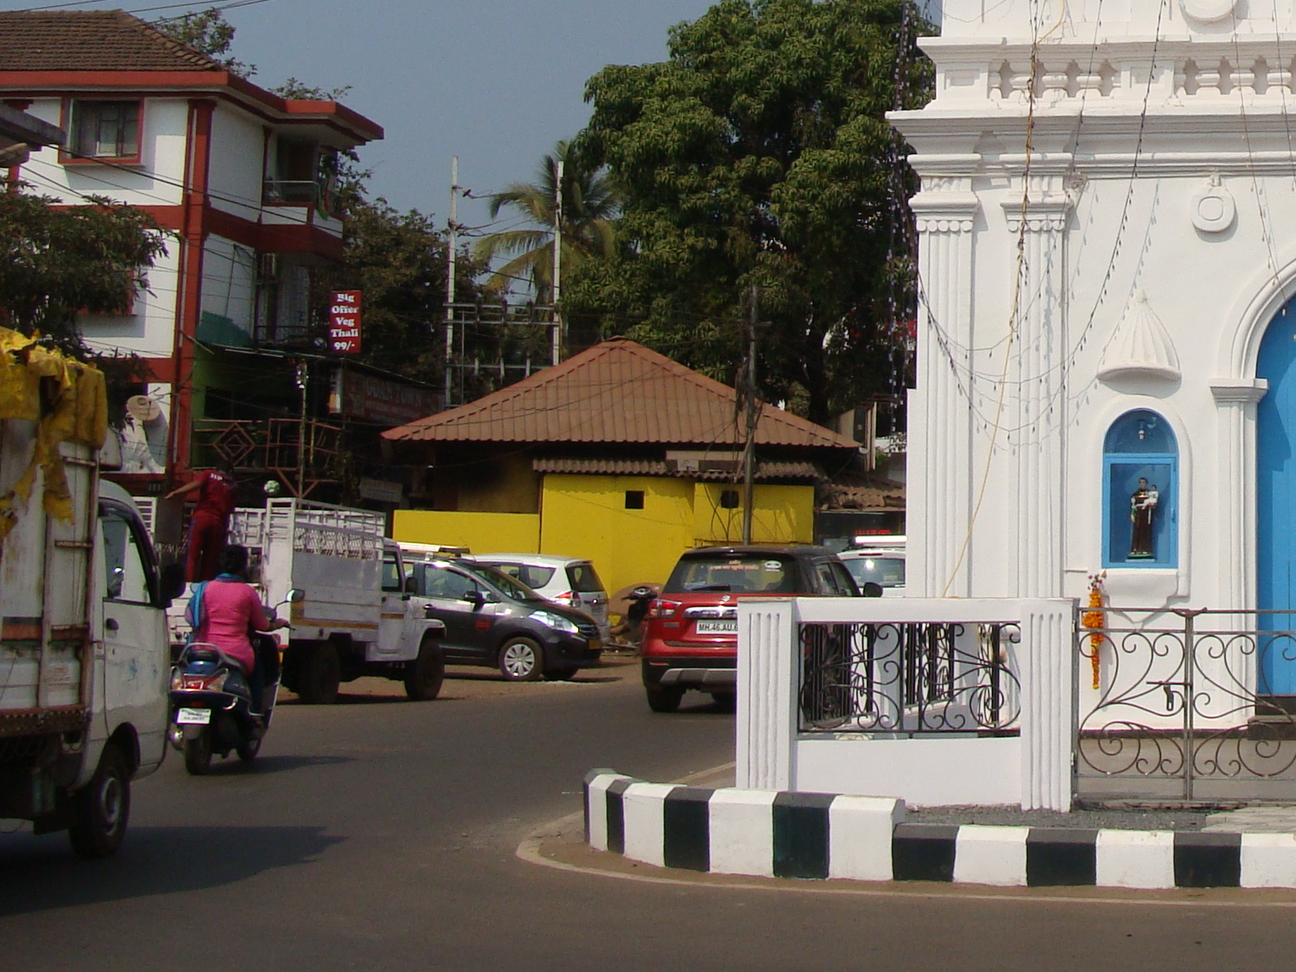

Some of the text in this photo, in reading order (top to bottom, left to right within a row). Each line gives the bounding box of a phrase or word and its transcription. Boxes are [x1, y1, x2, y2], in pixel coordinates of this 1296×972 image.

[336, 293, 355, 303] Big
[331, 305, 360, 314] Offer
[335, 317, 355, 327] Veg
[330, 328, 359, 338] Thali
[334, 340, 356, 351] 99/-
